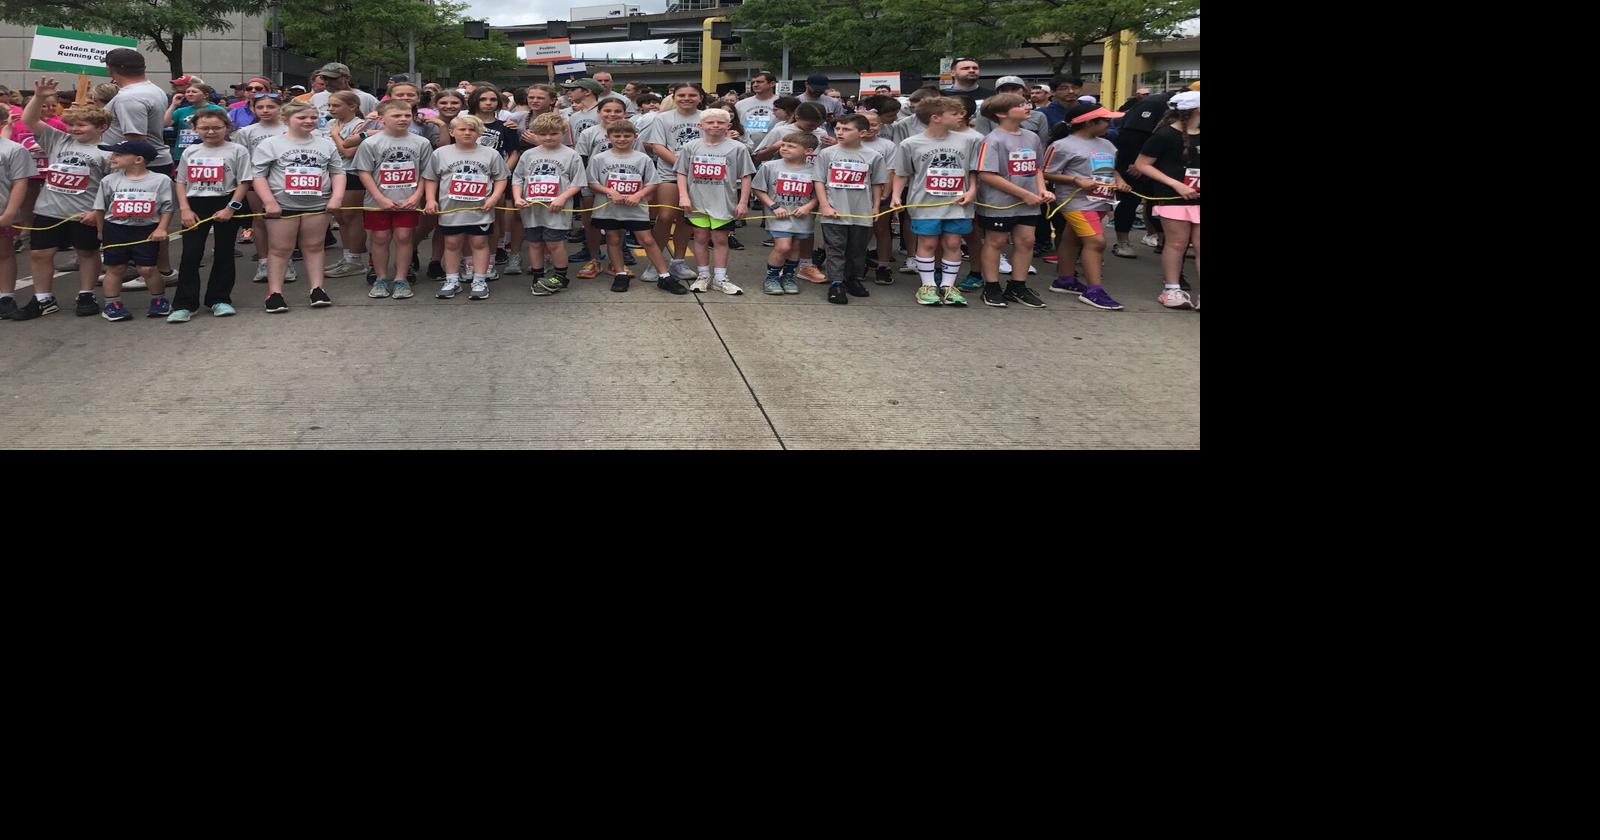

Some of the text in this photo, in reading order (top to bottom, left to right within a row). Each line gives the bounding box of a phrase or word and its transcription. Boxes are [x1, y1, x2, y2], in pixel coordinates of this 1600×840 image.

[59, 44, 88, 52] Golden
[57, 51, 92, 60] Running
[190, 167, 218, 178] 3701
[384, 170, 413, 182] 3672
[693, 164, 722, 176] 3668
[835, 170, 863, 182] 3716
[50, 172, 85, 187] 3727
[290, 176, 319, 188] 3691
[930, 177, 962, 188] 3697
[453, 182, 484, 194] 3707
[530, 183, 556, 195] 3692
[610, 181, 638, 192] 3665
[782, 181, 807, 193] 8141
[116, 202, 151, 213] 3669
